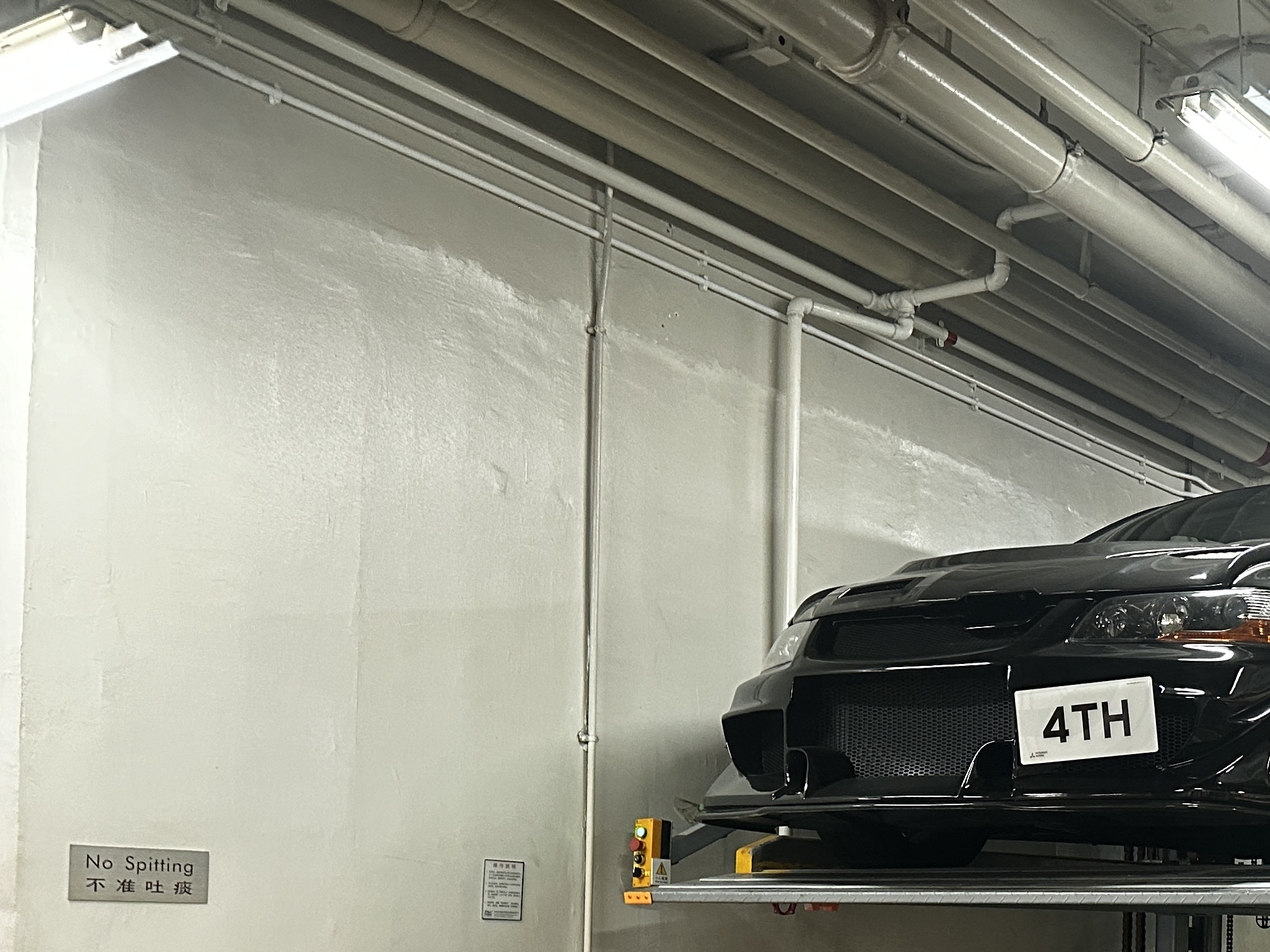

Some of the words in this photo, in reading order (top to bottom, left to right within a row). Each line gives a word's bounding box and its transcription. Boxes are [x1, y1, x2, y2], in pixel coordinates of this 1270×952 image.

[1042, 699, 1132, 743] 4TH
[86, 853, 113, 870] No
[125, 855, 194, 877] Spitting
[86, 877, 193, 896] 不准吐痰
